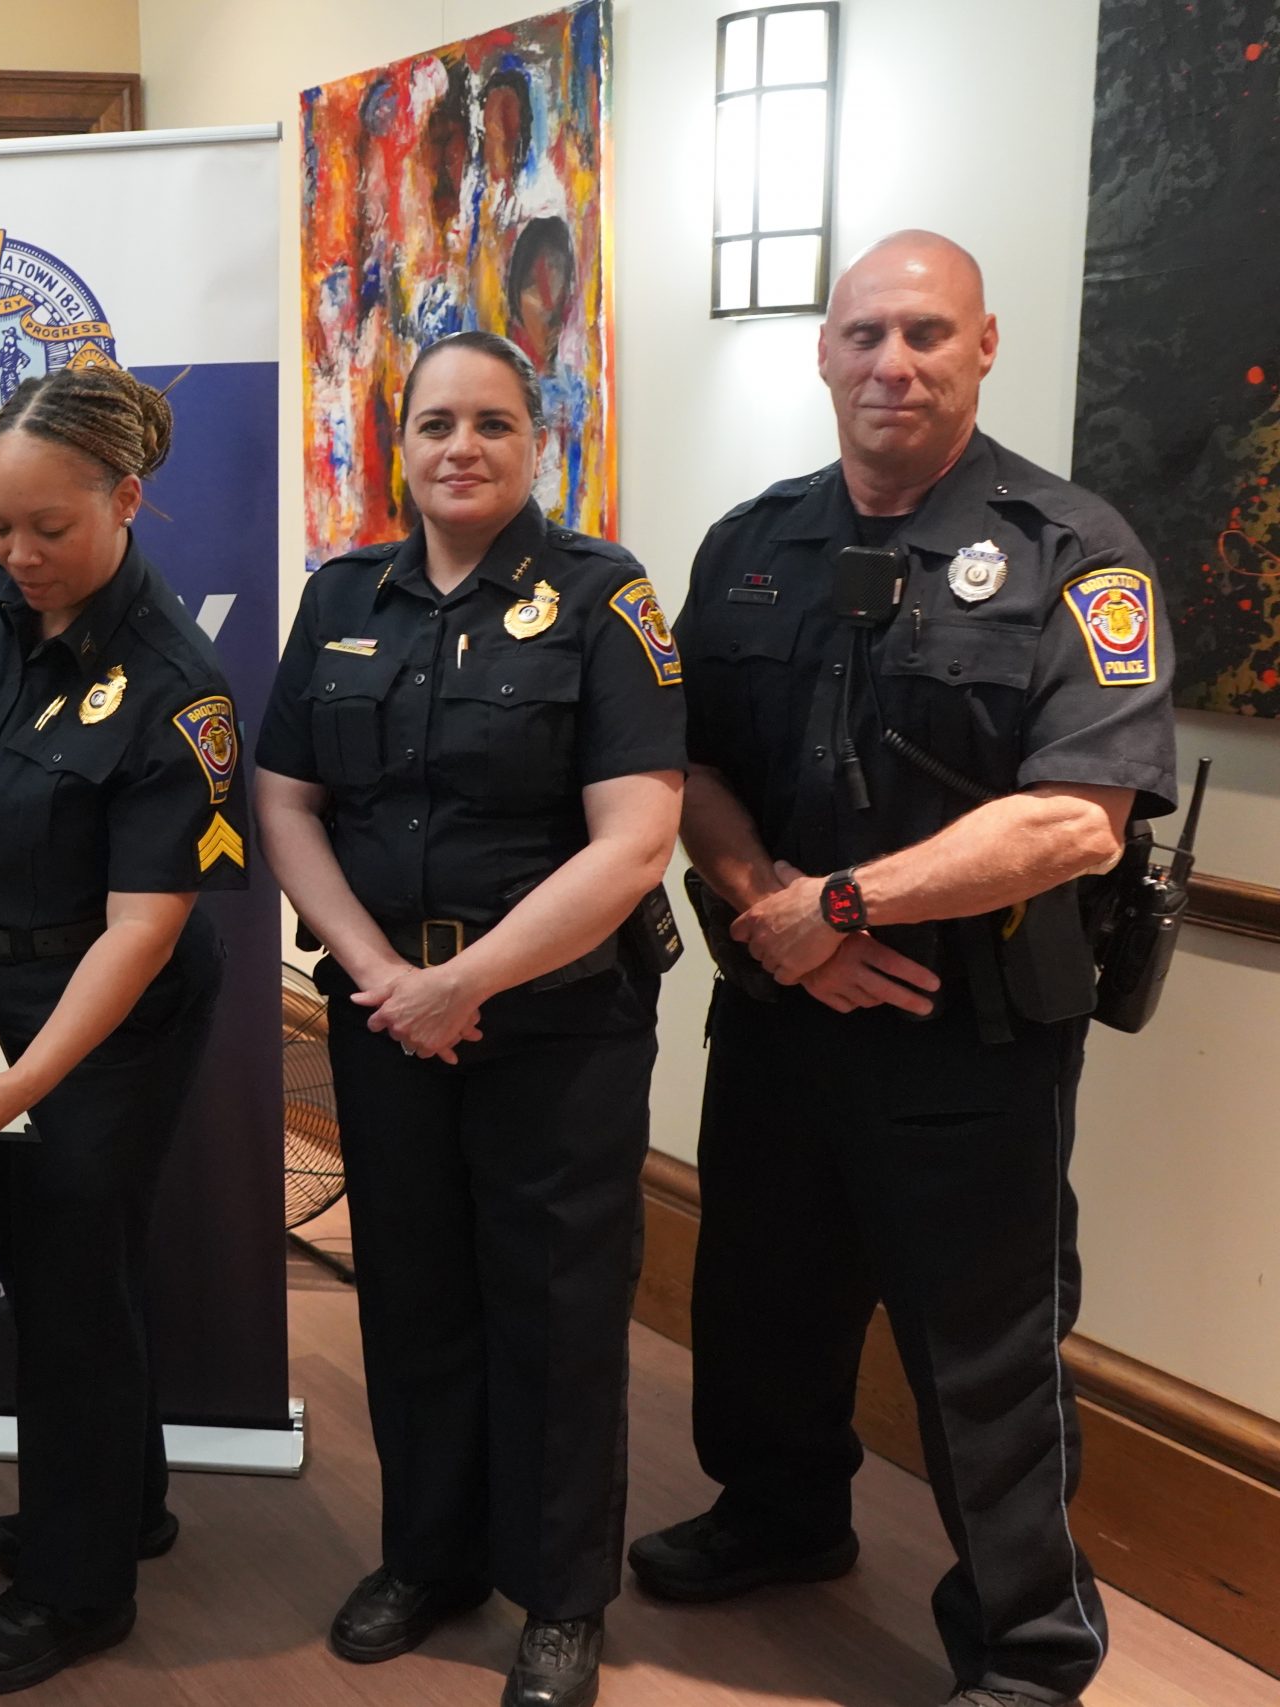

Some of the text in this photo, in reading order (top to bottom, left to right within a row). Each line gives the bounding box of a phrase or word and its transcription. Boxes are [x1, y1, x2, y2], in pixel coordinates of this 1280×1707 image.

[2, 255, 84, 321] A TOWN 1821
[25, 321, 102, 339] PROGRESS
[1078, 574, 1140, 595] BROCKTON
[1104, 660, 1146, 675] POLICE
